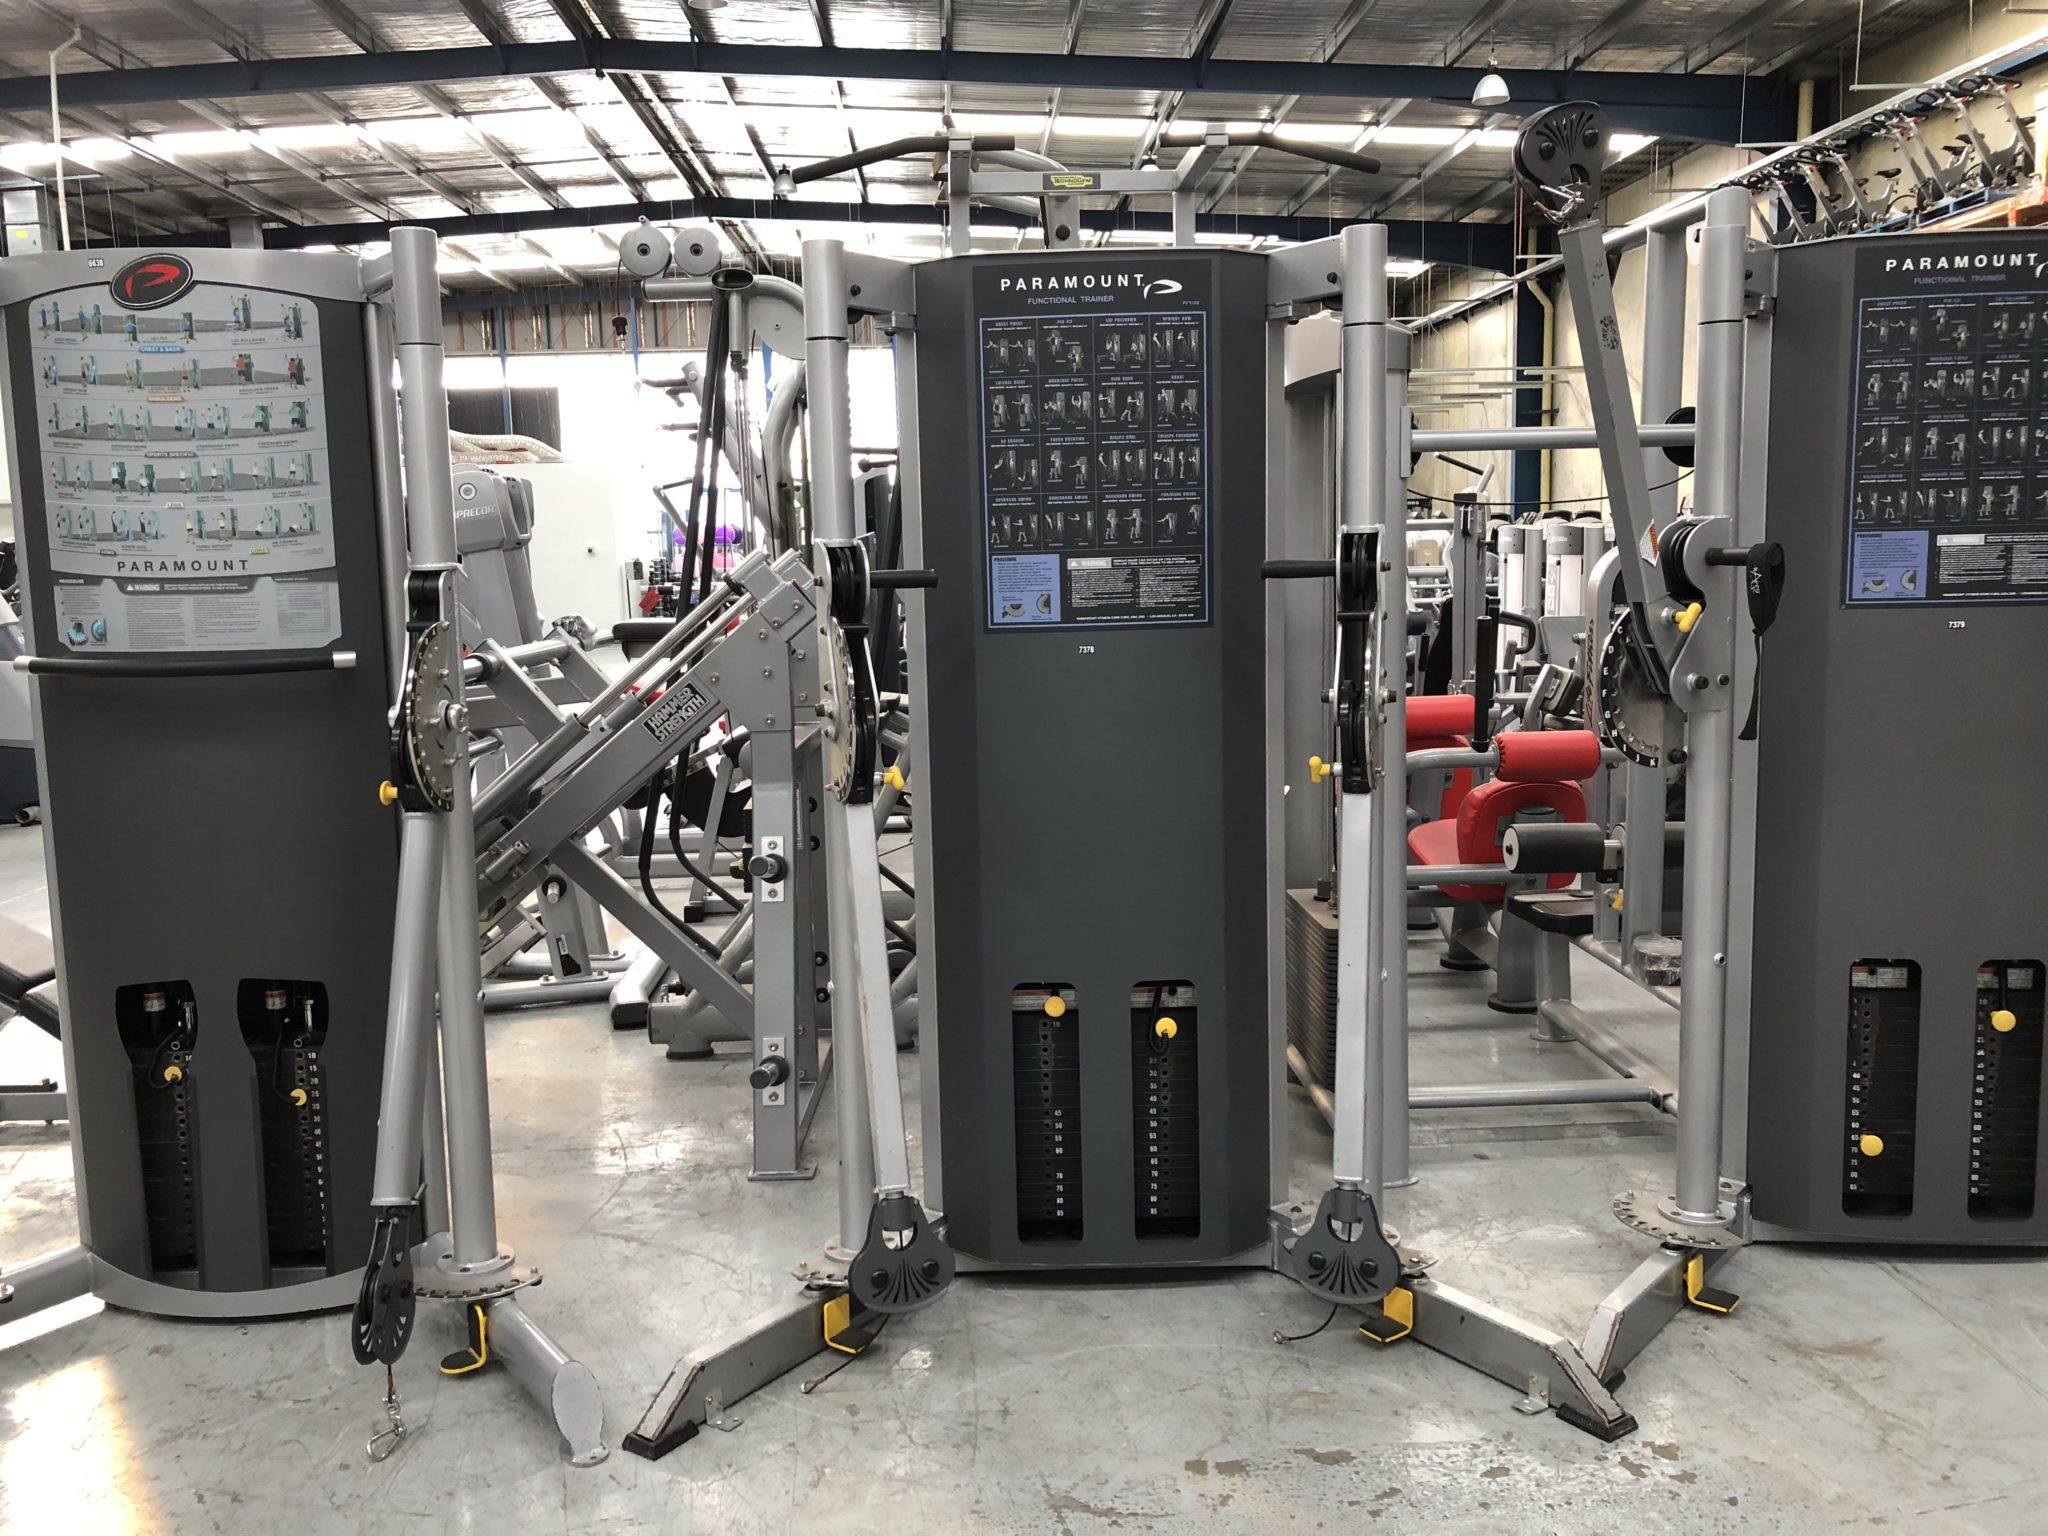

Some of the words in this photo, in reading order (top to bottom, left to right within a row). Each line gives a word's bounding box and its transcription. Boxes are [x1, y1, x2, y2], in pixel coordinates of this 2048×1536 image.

[88, 258, 104, 267] 6638
[1886, 253, 2038, 271] PARAMOUNT
[1001, 274, 1144, 291] PARAMOUNT
[1028, 296, 1077, 305] FUNCTIONAL
[1081, 295, 1114, 303] TRAINER
[456, 505, 495, 518] PRECOR
[117, 560, 249, 572] PARAMOUNT
[1948, 621, 1966, 629] 7379
[1608, 646, 1614, 654] D
[1603, 667, 1608, 675] E
[1602, 689, 1607, 697] F
[647, 687, 695, 730] HAMMER
[655, 694, 705, 742] STRENGTH
[1612, 729, 1617, 737] H
[1650, 758, 1655, 766] K
